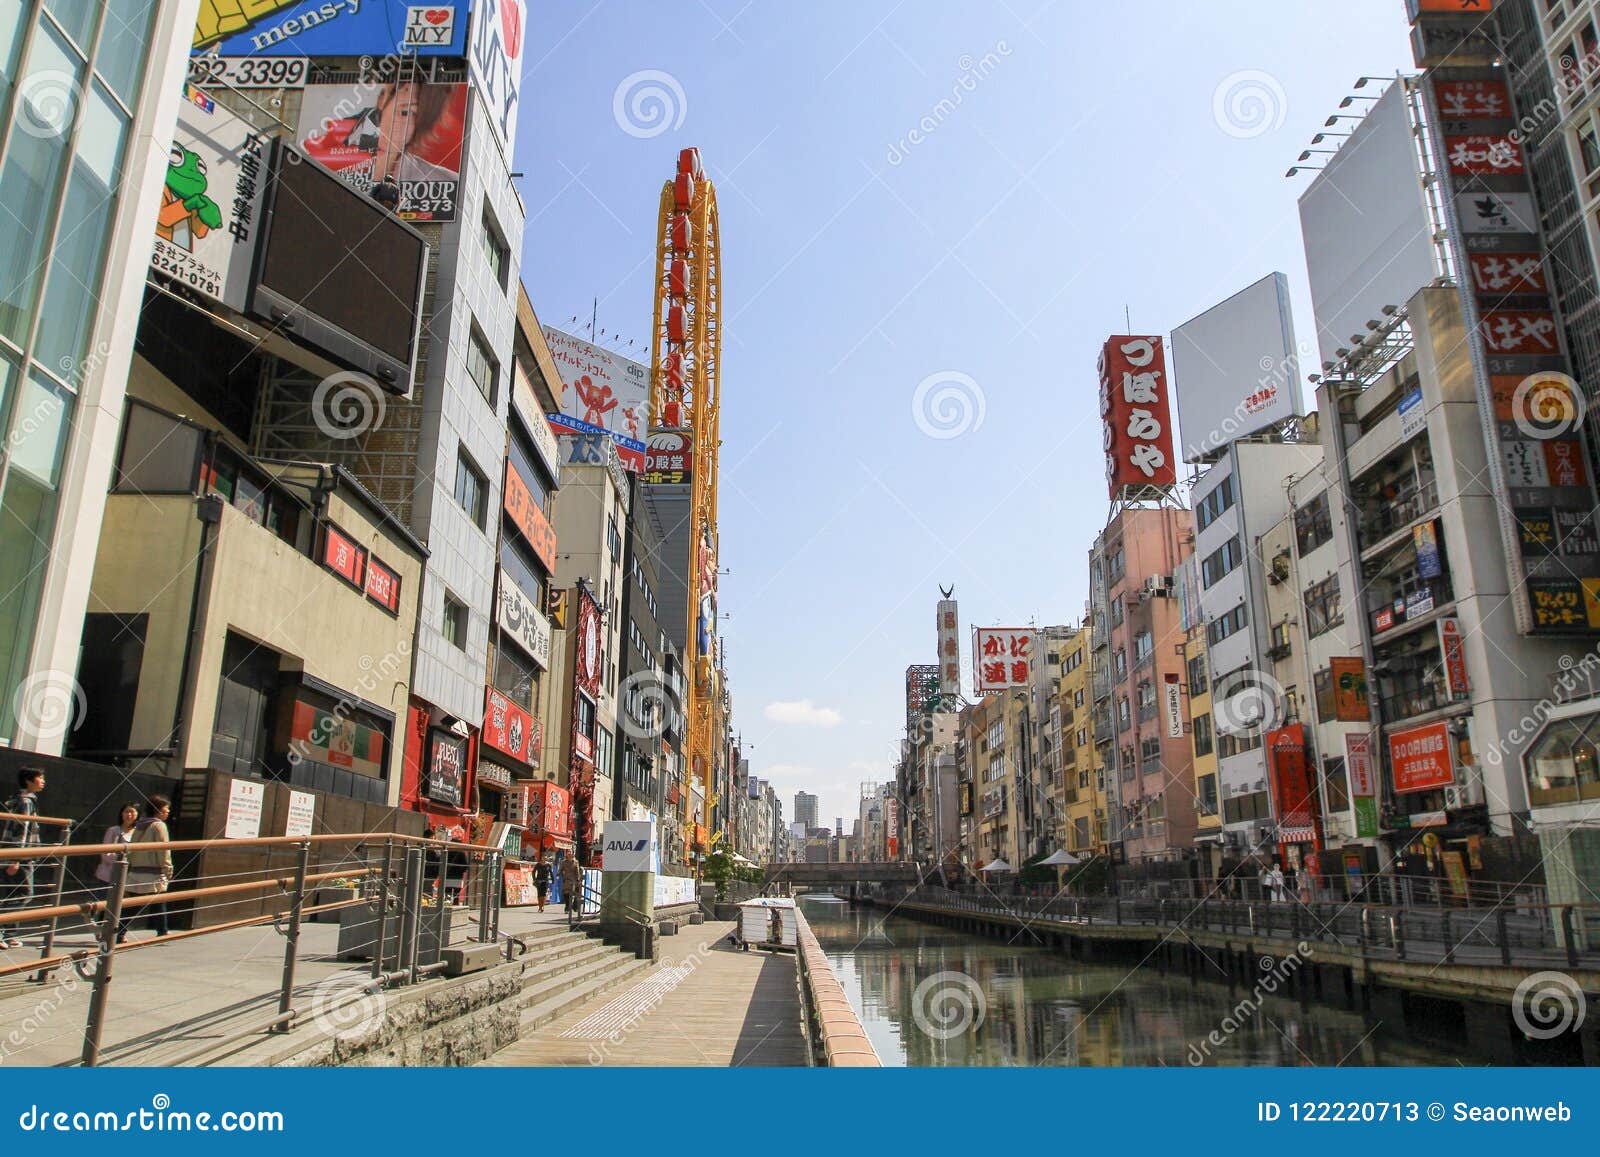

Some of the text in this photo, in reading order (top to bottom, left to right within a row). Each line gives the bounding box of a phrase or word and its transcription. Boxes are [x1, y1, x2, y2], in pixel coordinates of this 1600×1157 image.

[405, 27, 451, 43] MY
[153, 241, 223, 282] 会社プラネット
[151, 252, 220, 297] 6241-0781
[627, 364, 644, 379] dip
[336, 542, 348, 570] 酒
[368, 567, 392, 601] たばこ
[983, 635, 1030, 658] かに
[606, 840, 634, 851] ANA
